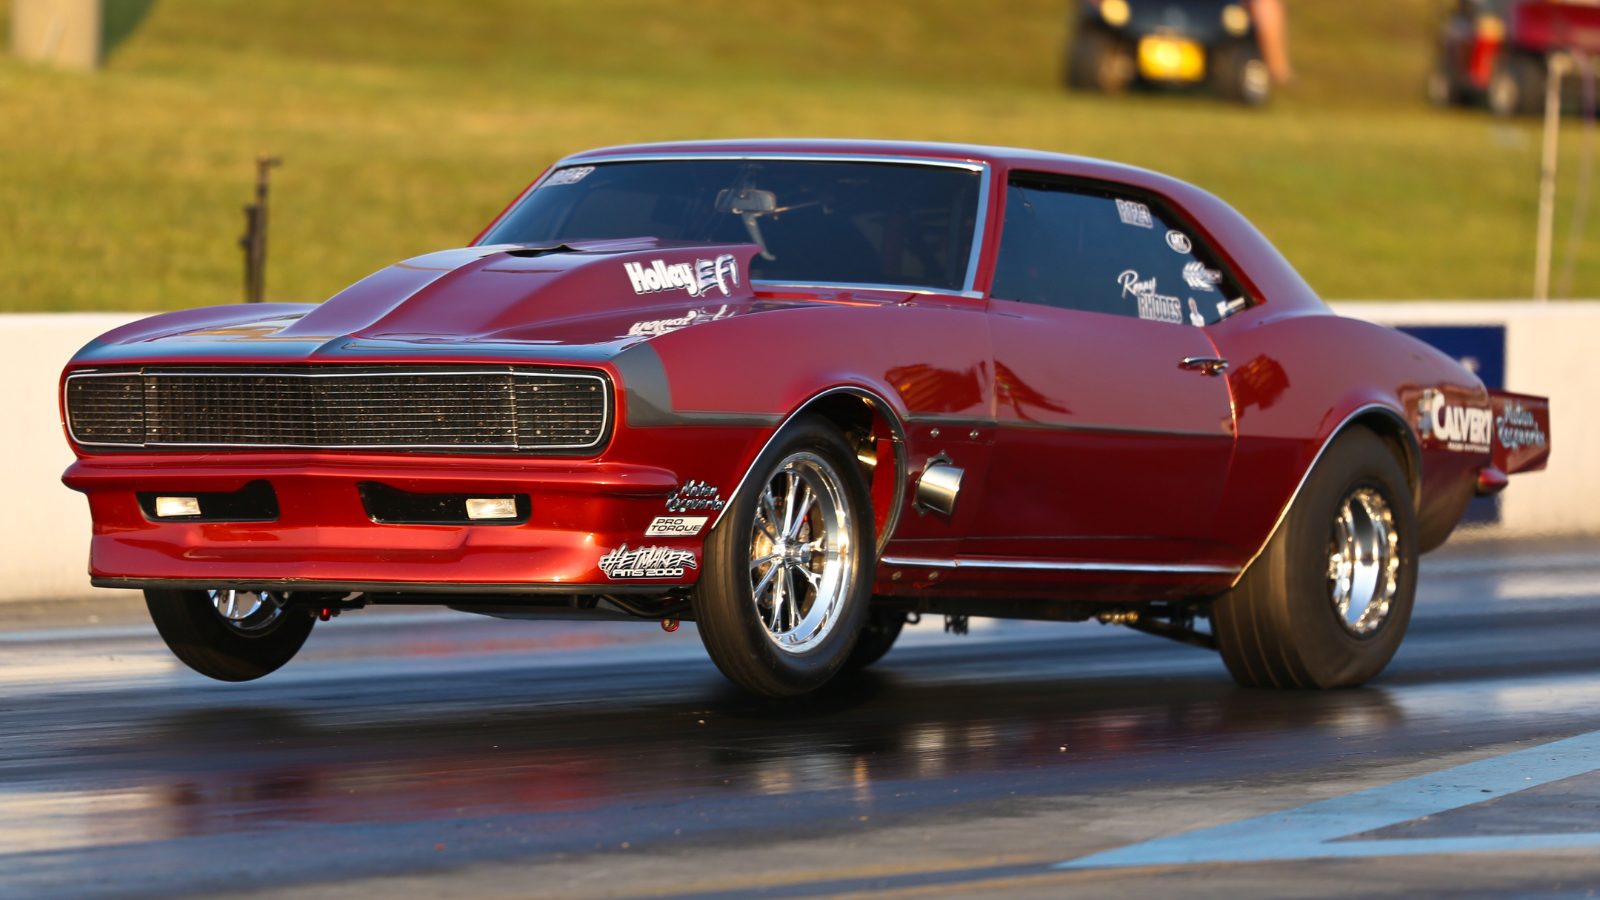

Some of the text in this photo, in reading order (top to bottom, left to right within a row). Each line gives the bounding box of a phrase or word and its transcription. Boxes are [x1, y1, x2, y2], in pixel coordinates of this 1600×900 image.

[624, 259, 698, 297] Holley
[1138, 294, 1182, 324] RHODES
[1431, 391, 1493, 445] CALVERT
[680, 480, 718, 497] Motion
[665, 492, 726, 512] Raceworks
[645, 568, 684, 576] 2000
